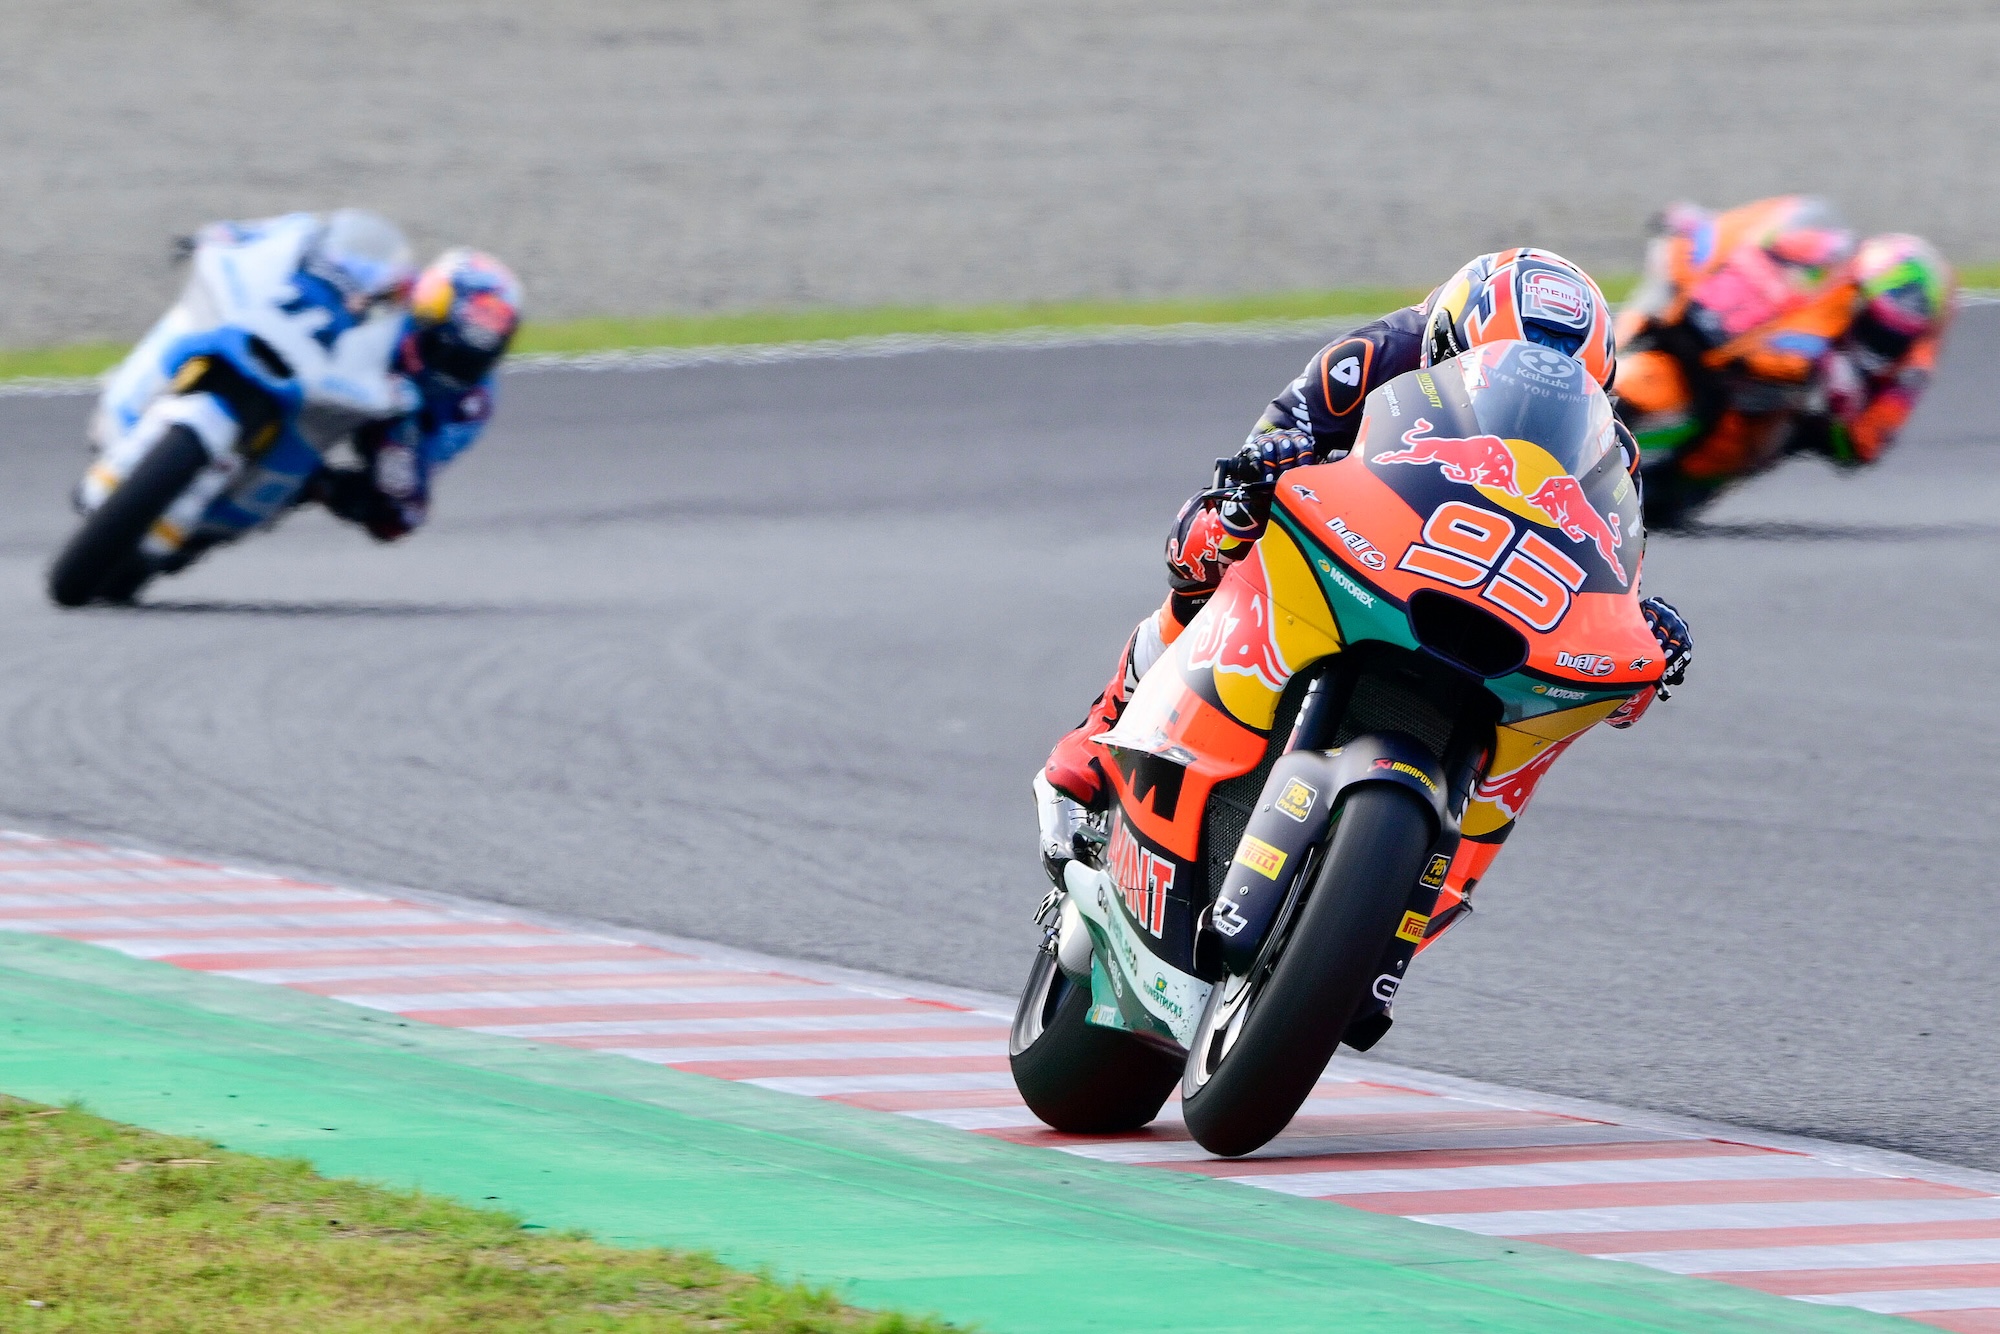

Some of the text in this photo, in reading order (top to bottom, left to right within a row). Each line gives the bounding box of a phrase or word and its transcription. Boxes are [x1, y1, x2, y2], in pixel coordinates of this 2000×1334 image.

[1415, 373, 1443, 408] MOTOBATT
[1523, 382, 1550, 398] YOU
[1330, 567, 1374, 609] MOTOREX
[1544, 687, 1590, 700] MOTOREX
